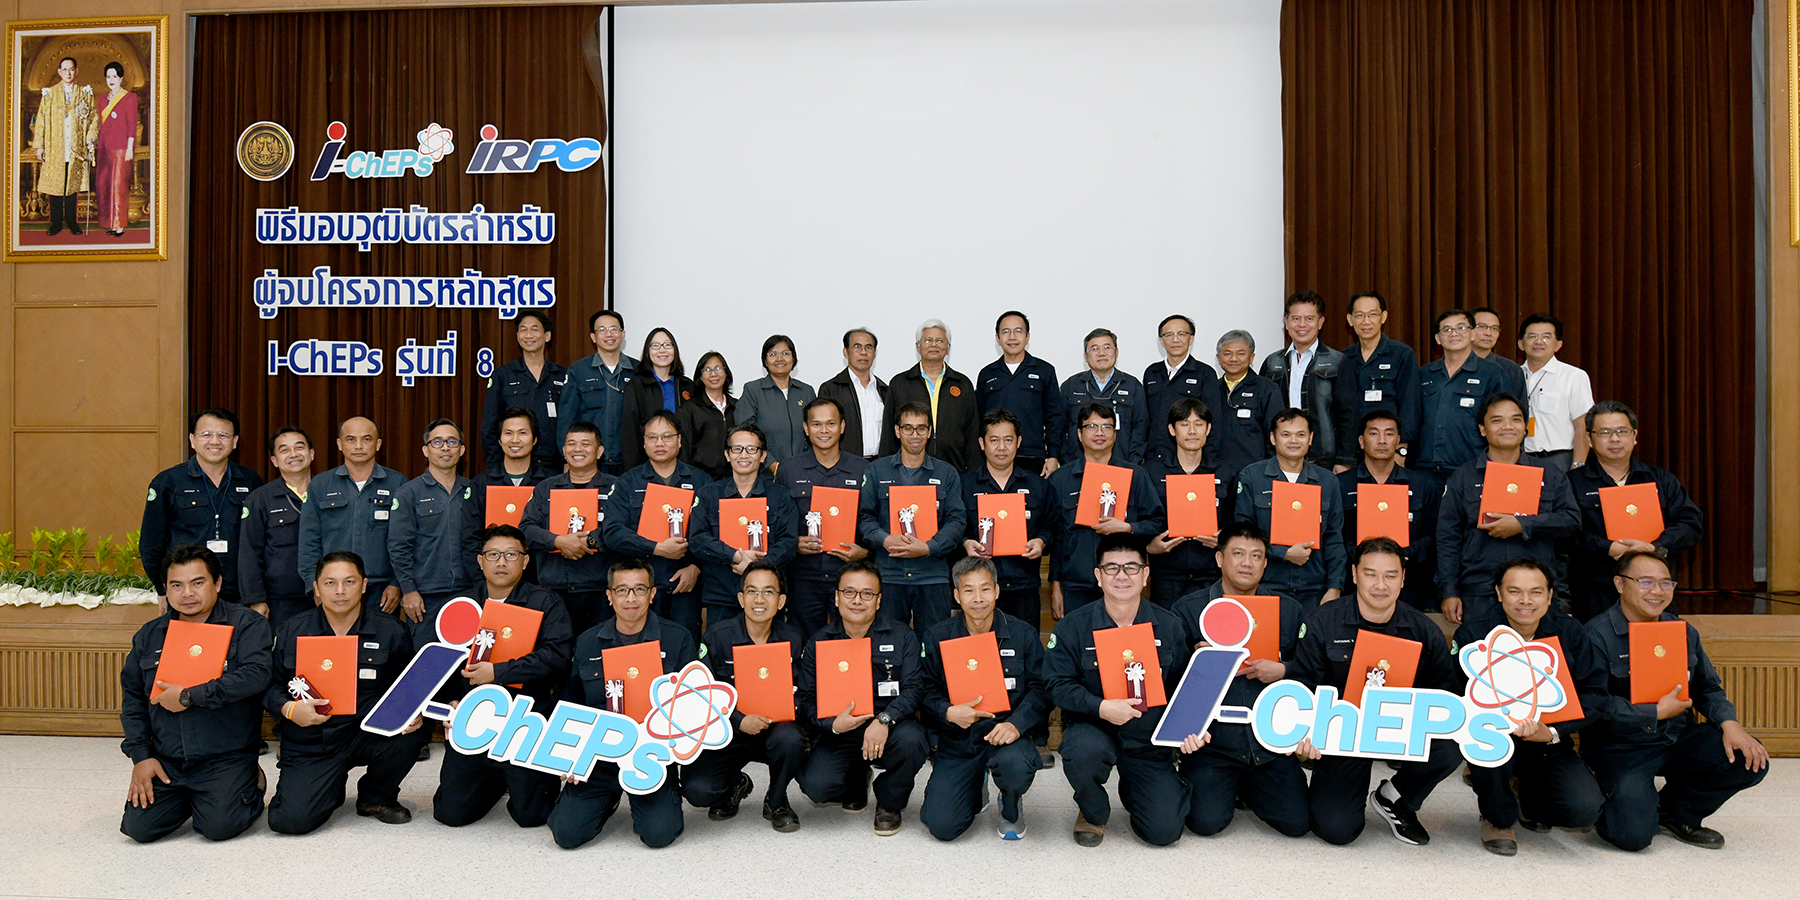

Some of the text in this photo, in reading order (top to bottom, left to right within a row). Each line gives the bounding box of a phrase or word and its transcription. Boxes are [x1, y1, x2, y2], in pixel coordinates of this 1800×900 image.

[256, 204, 554, 250] พิธีมอบวุฒิบัตรสำหรับ
[254, 267, 555, 318] ผู้จบโครงการหลักสูตร
[270, 333, 493, 385] I-ChEPs รุ่นที่ 8
